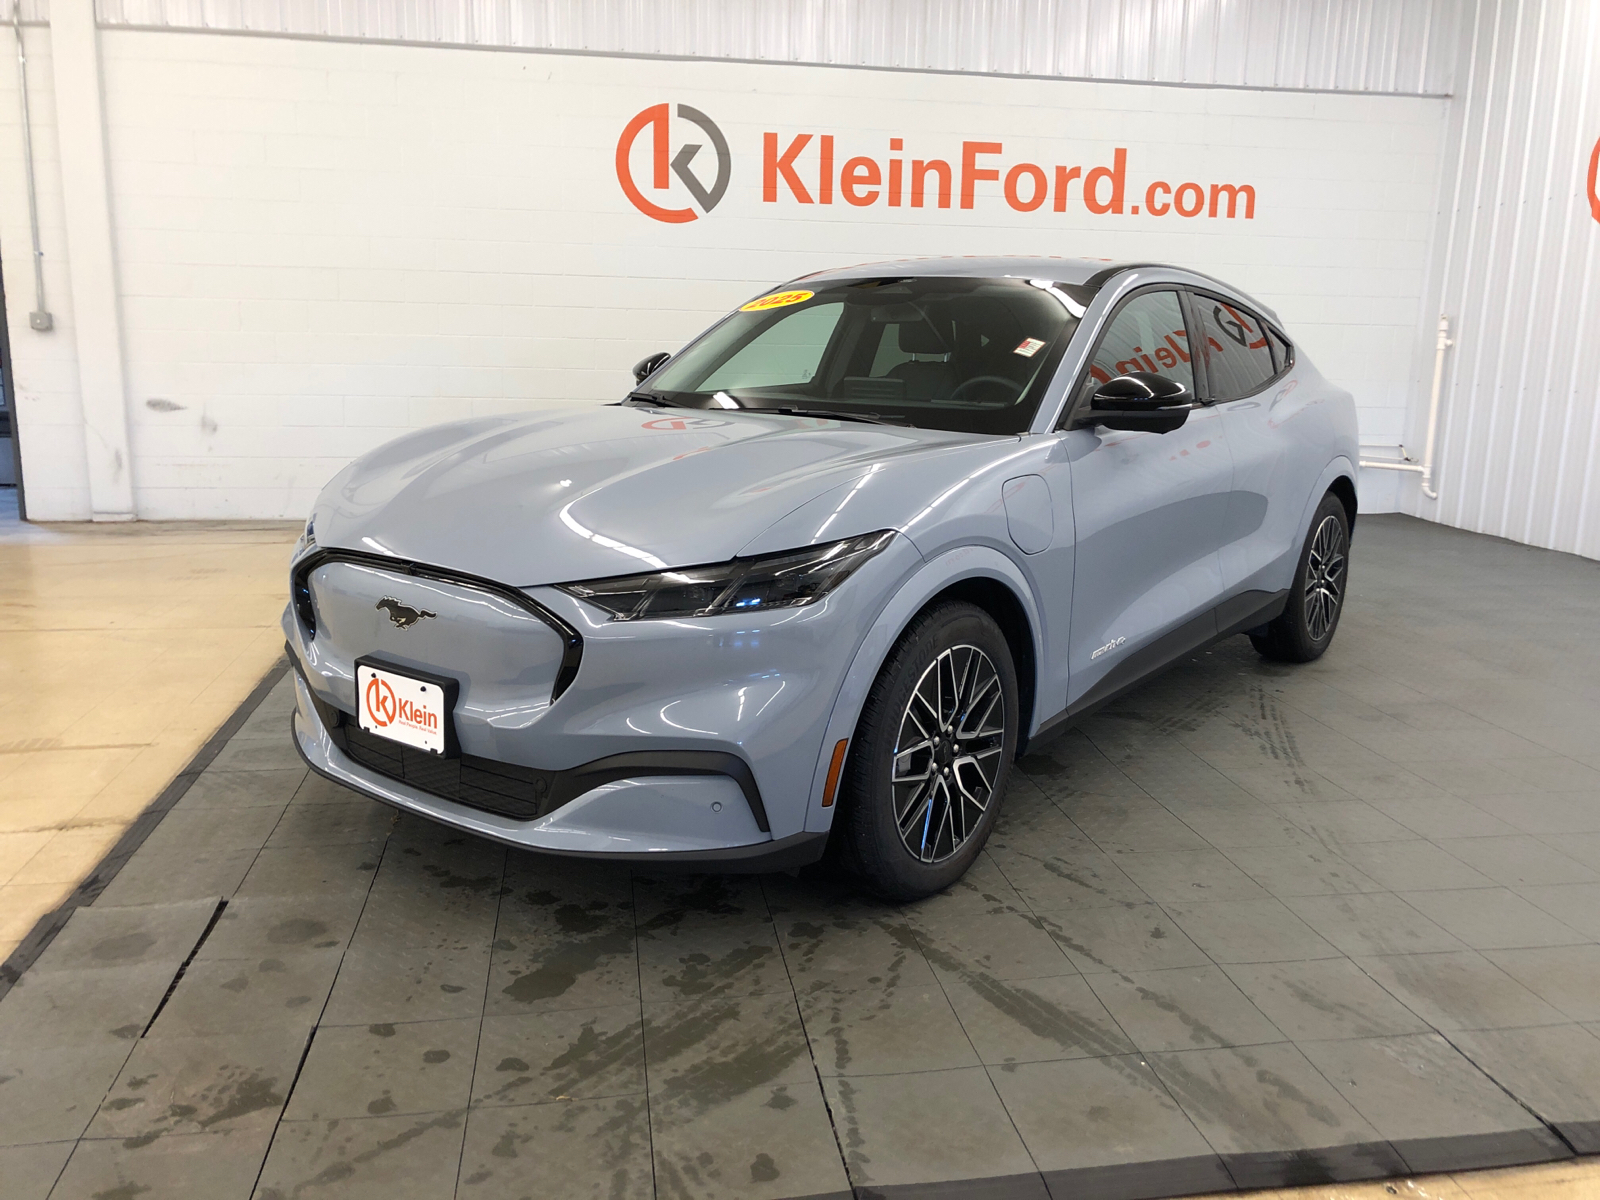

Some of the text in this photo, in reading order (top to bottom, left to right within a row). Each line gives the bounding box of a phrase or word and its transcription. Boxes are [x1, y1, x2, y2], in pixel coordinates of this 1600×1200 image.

[763, 131, 1255, 219] KleinFord.com
[744, 292, 809, 309] 2025
[398, 697, 438, 729] Klein
[884, 633, 939, 752] RIDGESTONE
